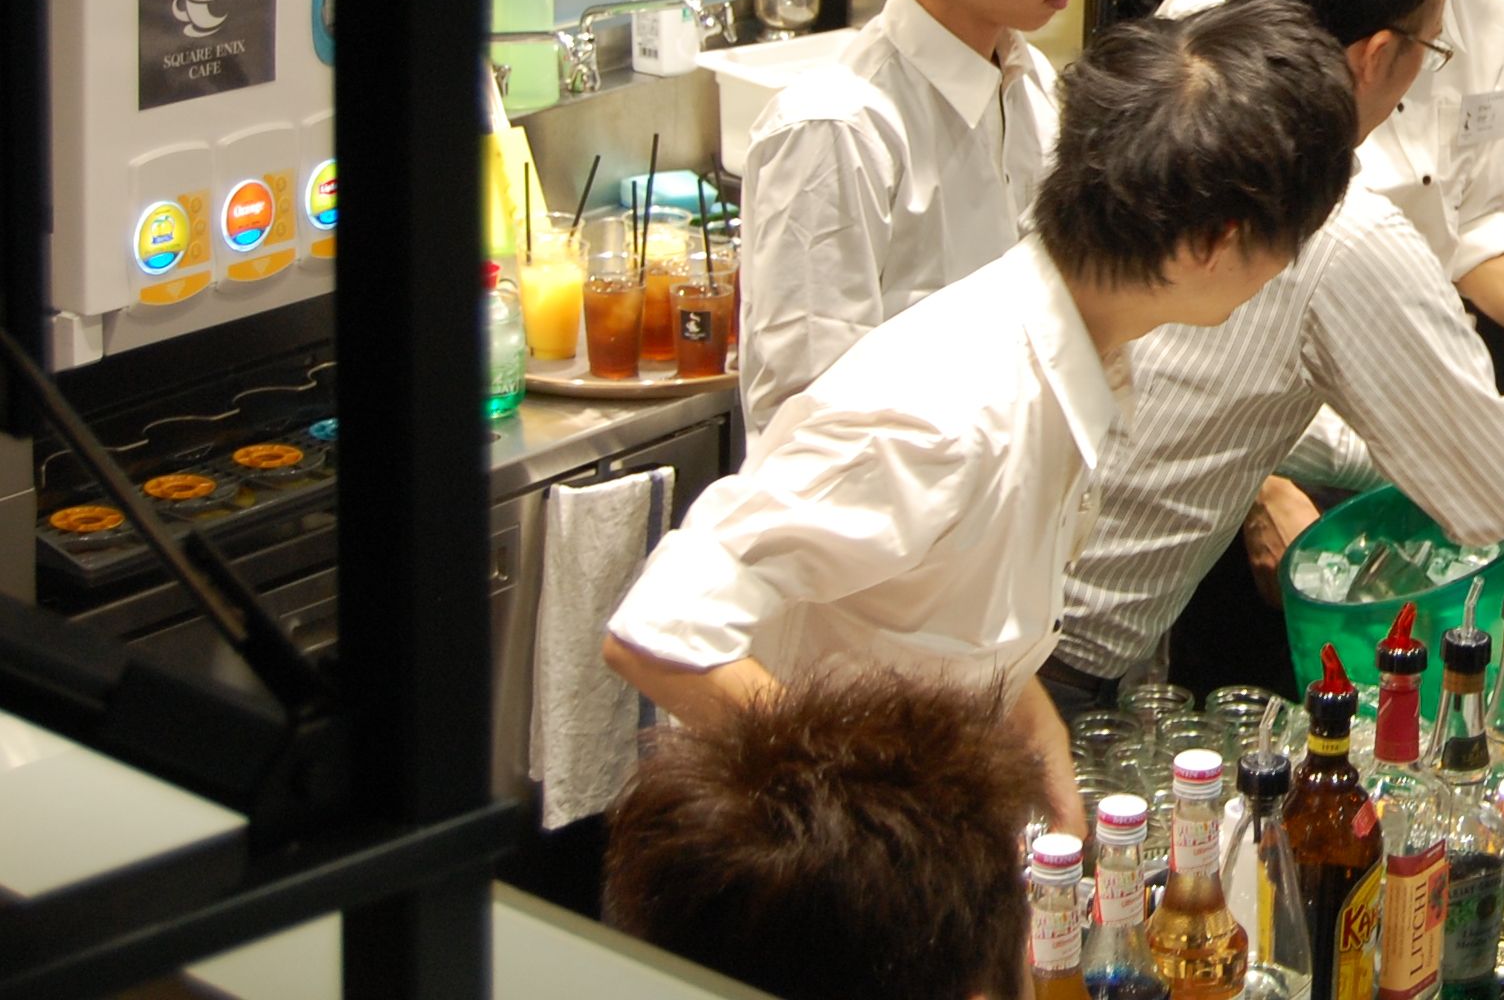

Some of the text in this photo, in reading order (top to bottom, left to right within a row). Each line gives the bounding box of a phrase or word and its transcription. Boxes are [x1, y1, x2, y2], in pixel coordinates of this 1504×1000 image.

[162, 39, 246, 69] SQUARE ENIX
[188, 60, 222, 80] CAFE
[1409, 880, 1428, 978] LITCHI
